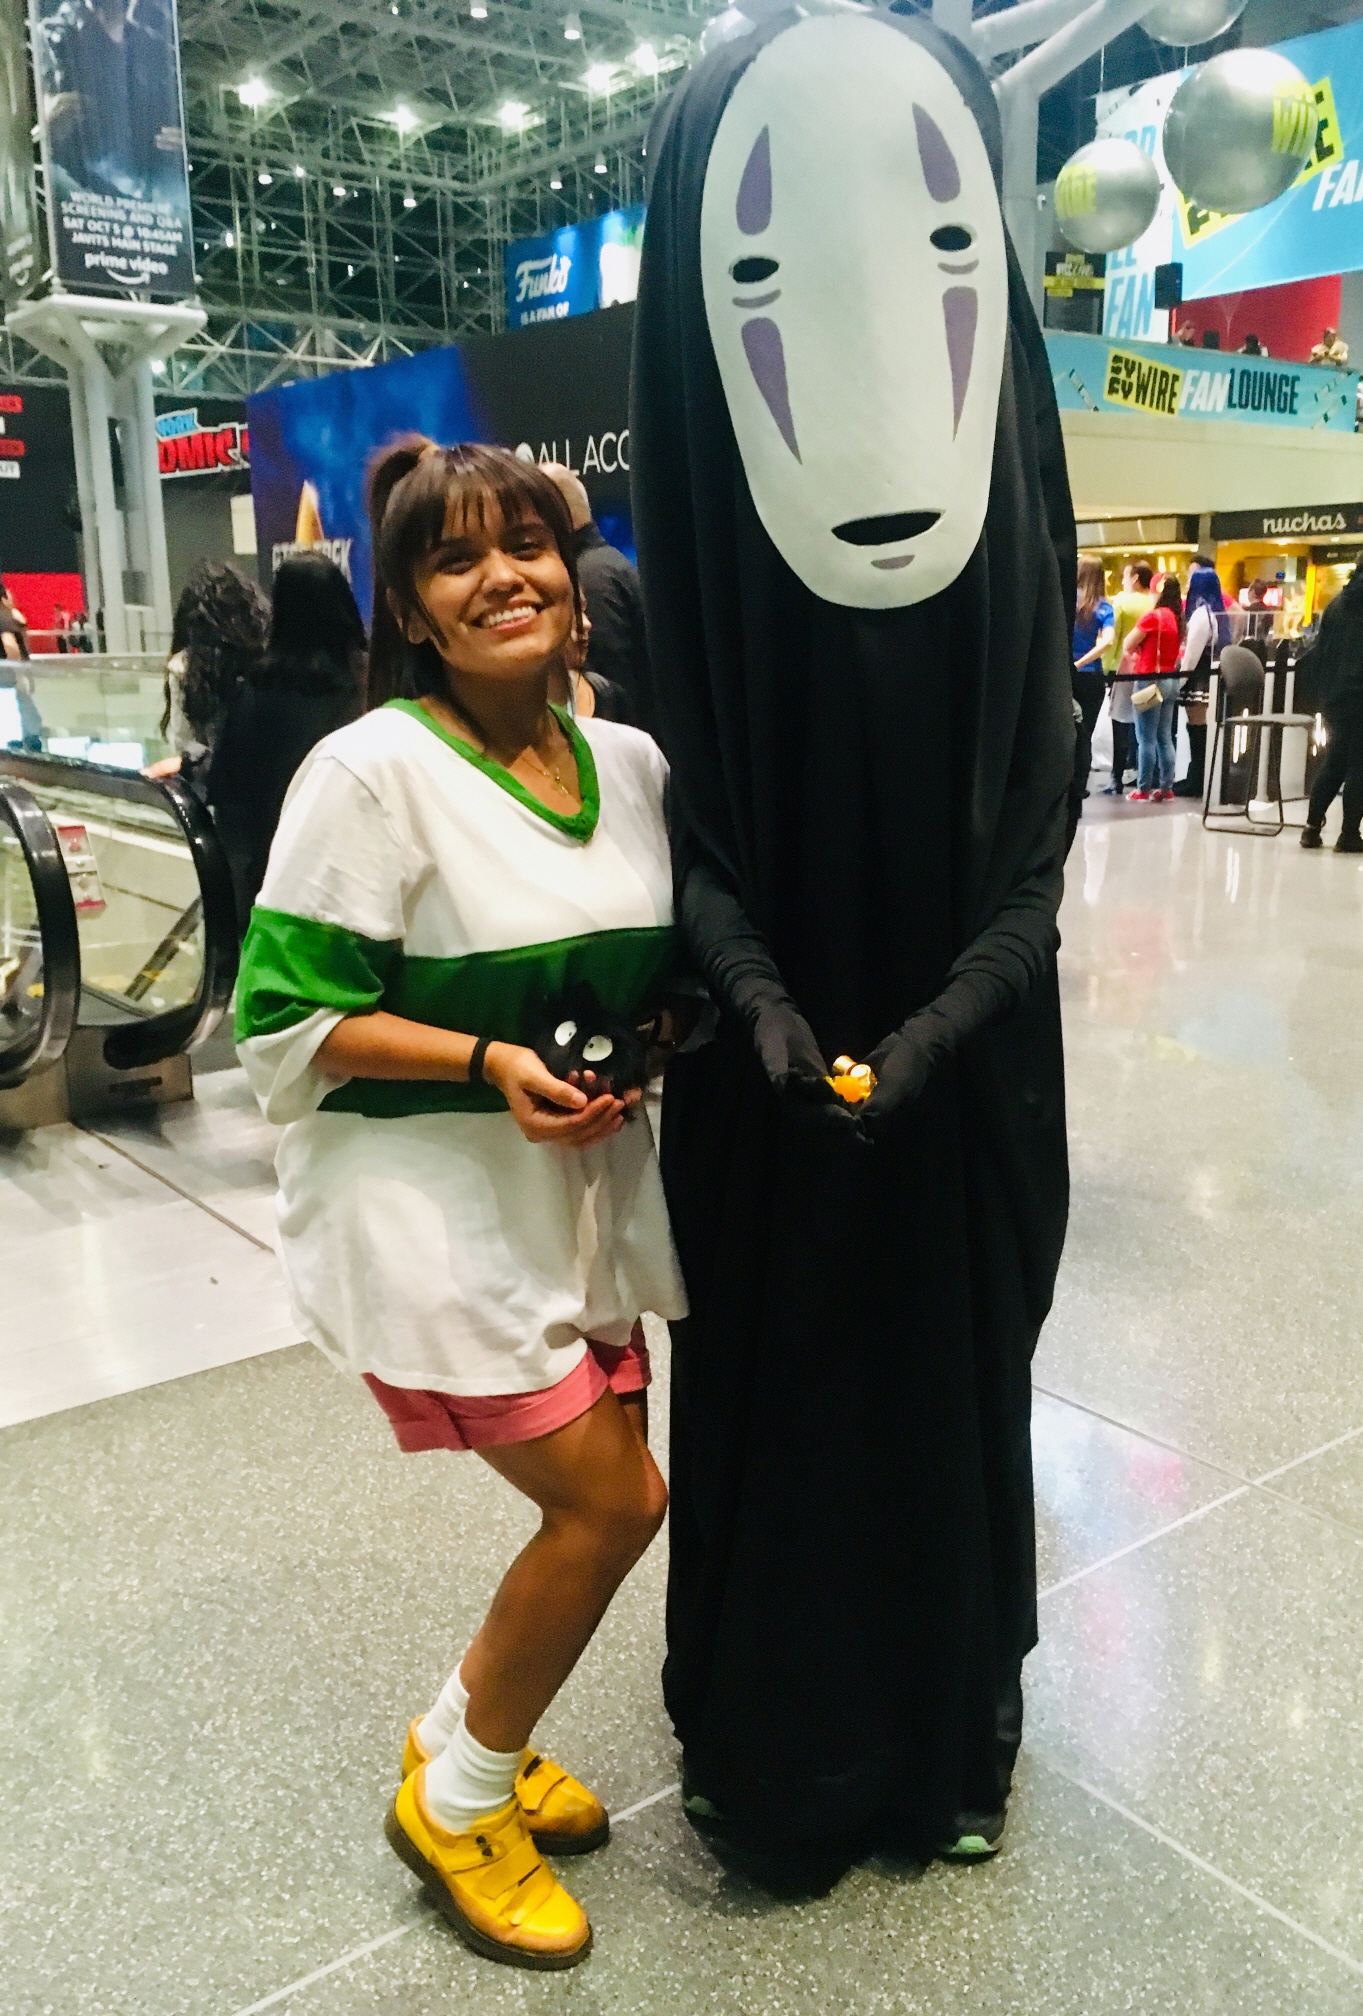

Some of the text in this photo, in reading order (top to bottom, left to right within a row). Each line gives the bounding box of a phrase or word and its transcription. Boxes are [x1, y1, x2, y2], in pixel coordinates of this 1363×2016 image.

[70, 191, 114, 207] WORLD
[61, 201, 127, 221] SCREENING
[129, 211, 154, 226] AND
[63, 216, 85, 230] SAT
[87, 218, 111, 234] OCT
[122, 225, 135, 238] @
[72, 231, 178, 256] JAVITS MAIN STAGE
[84, 251, 169, 275] prime video
[515, 253, 571, 302] Funko
[1134, 361, 1301, 415] WIRE FAN LOUNGE
[157, 428, 234, 474] OMIC
[1262, 512, 1347, 534] nuchas
